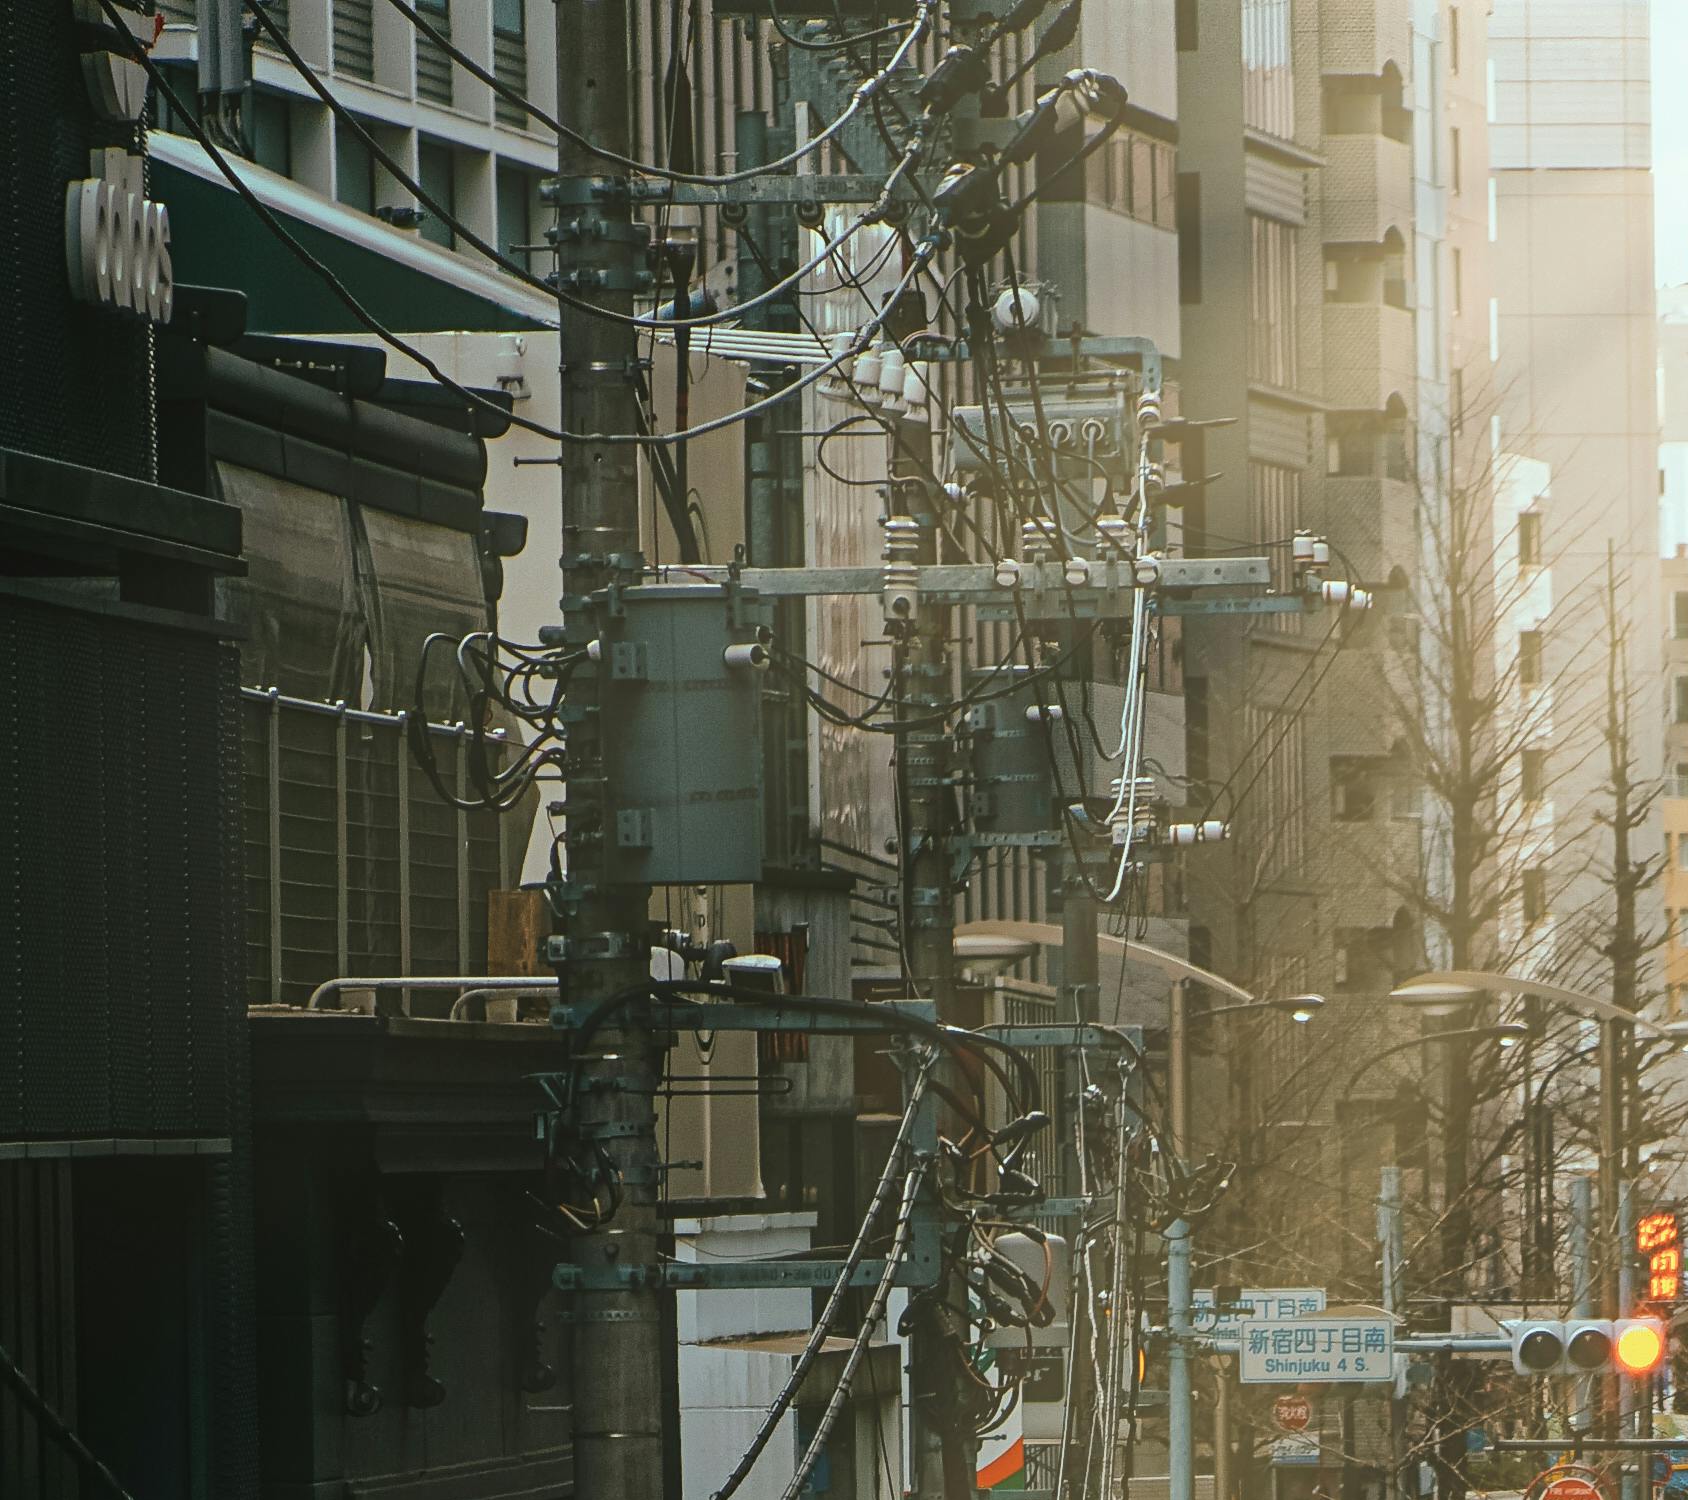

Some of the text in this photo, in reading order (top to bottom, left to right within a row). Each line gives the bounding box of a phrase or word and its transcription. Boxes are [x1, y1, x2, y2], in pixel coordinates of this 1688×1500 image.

[1248, 1327, 1386, 1355] 新宿四丁目南
[1265, 1358, 1369, 1375] Shinjuku 4 S.
